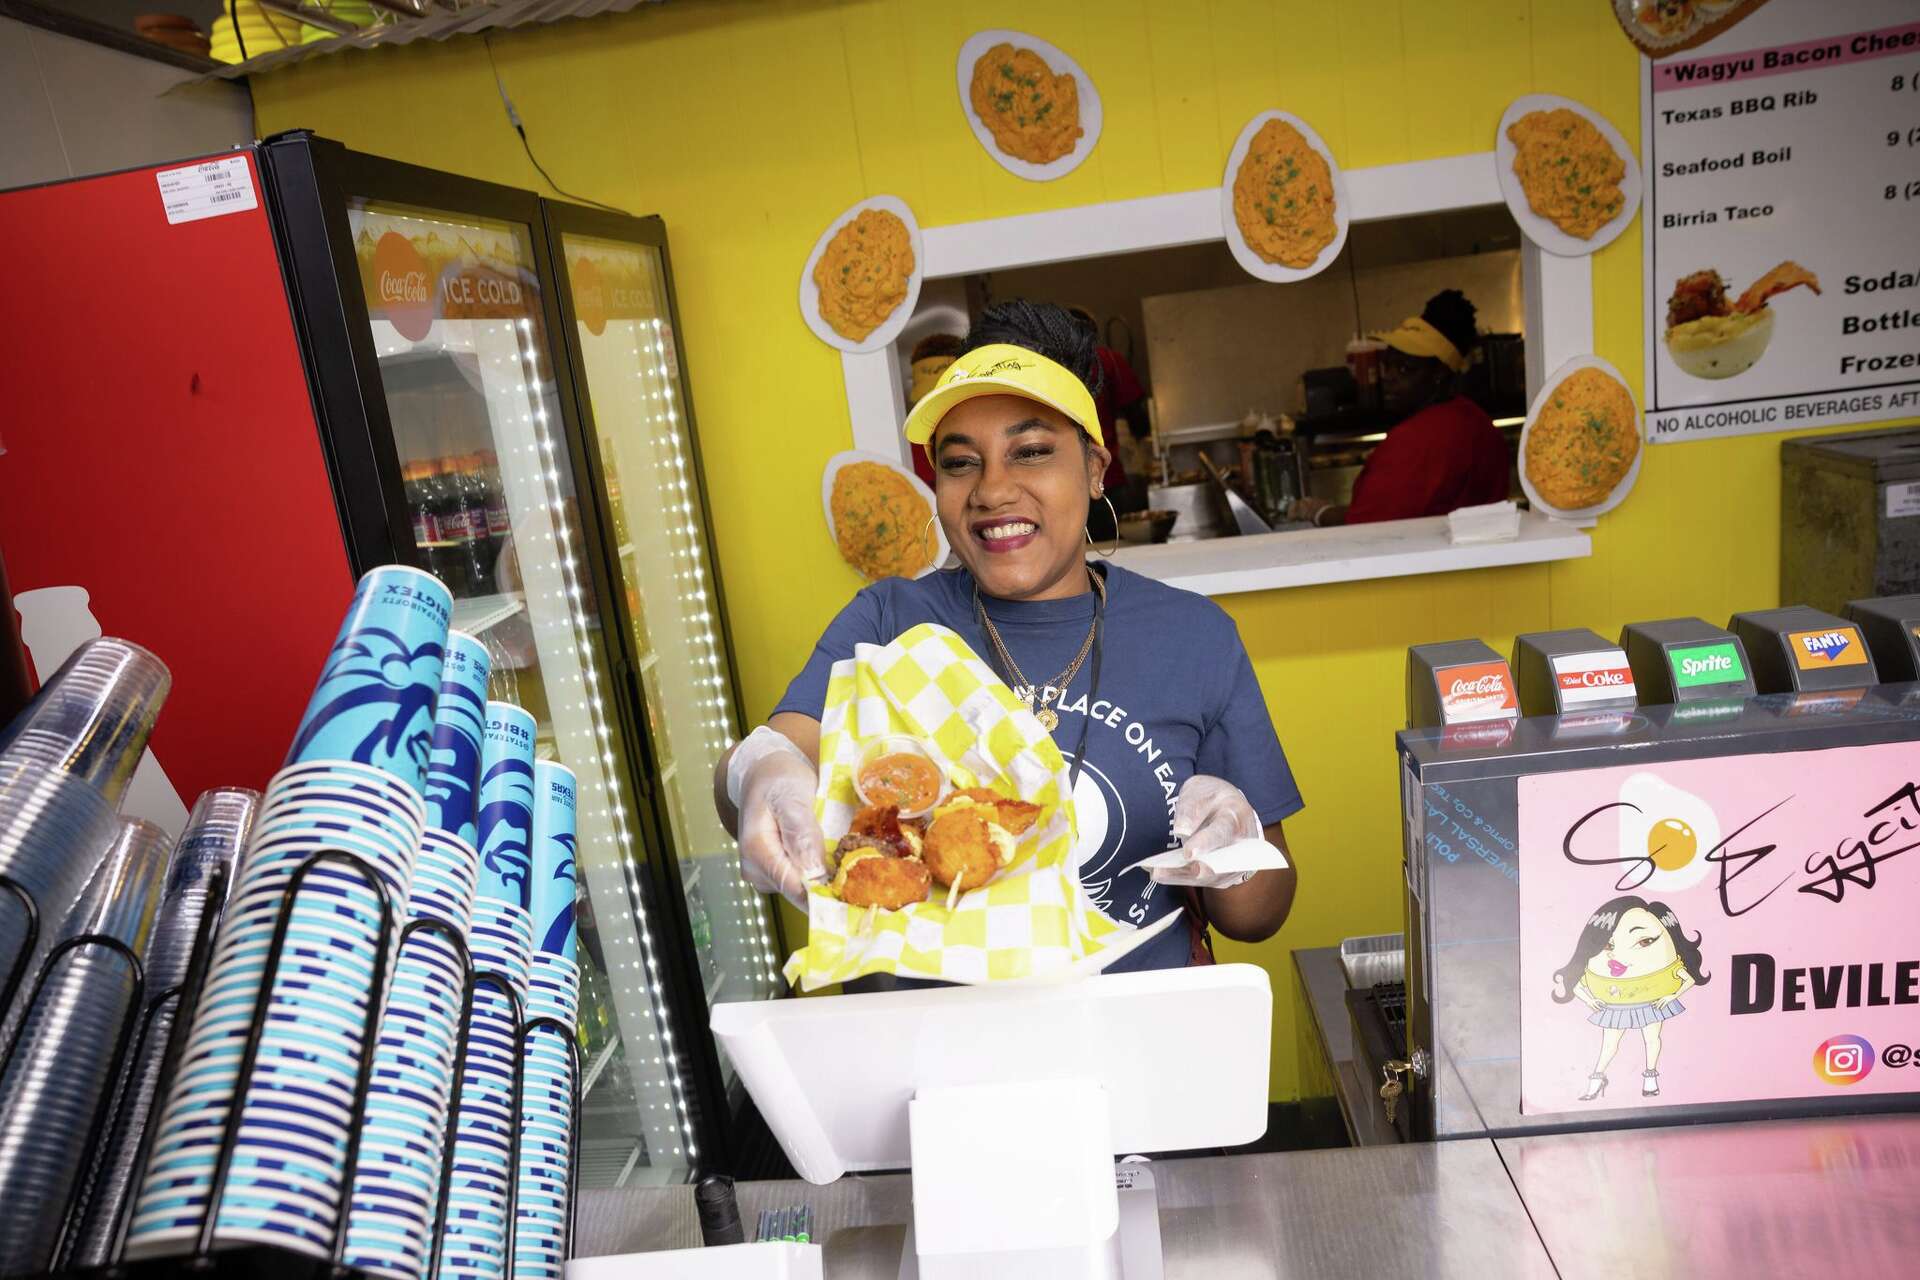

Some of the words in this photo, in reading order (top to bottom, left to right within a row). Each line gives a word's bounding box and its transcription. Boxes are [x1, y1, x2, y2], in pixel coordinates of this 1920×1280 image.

[1763, 44, 1842, 70] Bacon
[1891, 75, 1904, 91] 8
[1662, 106, 1723, 125] Texas
[1731, 95, 1776, 117] BBQ
[1783, 90, 1818, 108] Rib
[1887, 131, 1900, 147] 9
[1662, 153, 1744, 178] Seafood
[1752, 146, 1792, 166] Boil
[1884, 184, 1897, 200] 8
[1663, 209, 1718, 229] Birria
[1725, 204, 1774, 221] Taco
[380, 270, 428, 304] Coca-Cola
[442, 276, 475, 305] ICE
[477, 277, 523, 305] COLD
[1656, 417, 1680, 434] NO
[1685, 406, 1777, 431] ALCOHOLIC
[1785, 394, 1882, 420] BEVERAGES
[1803, 631, 1849, 652] FANTA
[1681, 653, 1732, 677] Sprite
[1450, 674, 1505, 698] Coca-Cola
[1563, 676, 1582, 686] Diet
[1583, 670, 1625, 688] Coke
[1042, 684, 1128, 729] PLACE
[1125, 722, 1162, 763] ON
